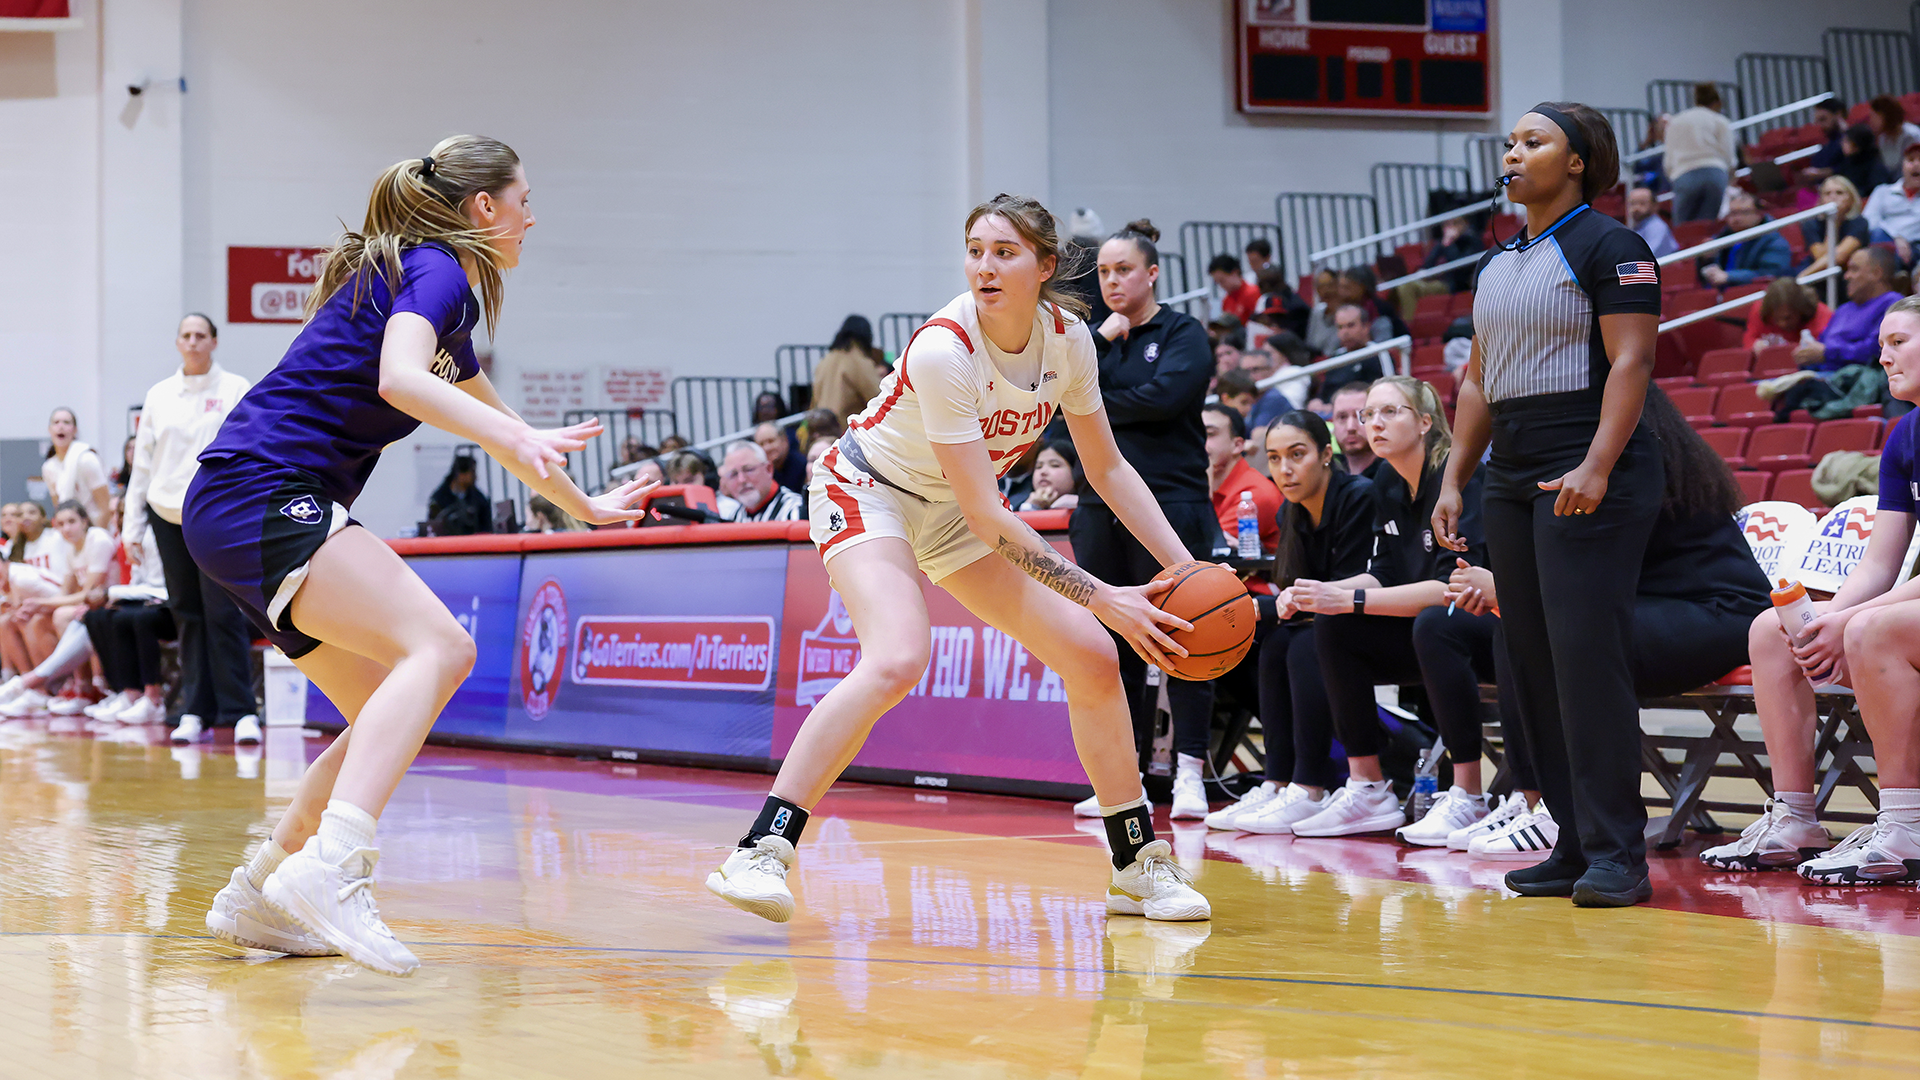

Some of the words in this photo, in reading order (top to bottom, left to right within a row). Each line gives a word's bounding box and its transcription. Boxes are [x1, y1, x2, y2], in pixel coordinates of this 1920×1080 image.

[1807, 540, 1865, 560] PATRI
[1800, 556, 1857, 576] LEA
[982, 627, 1031, 701] WE
